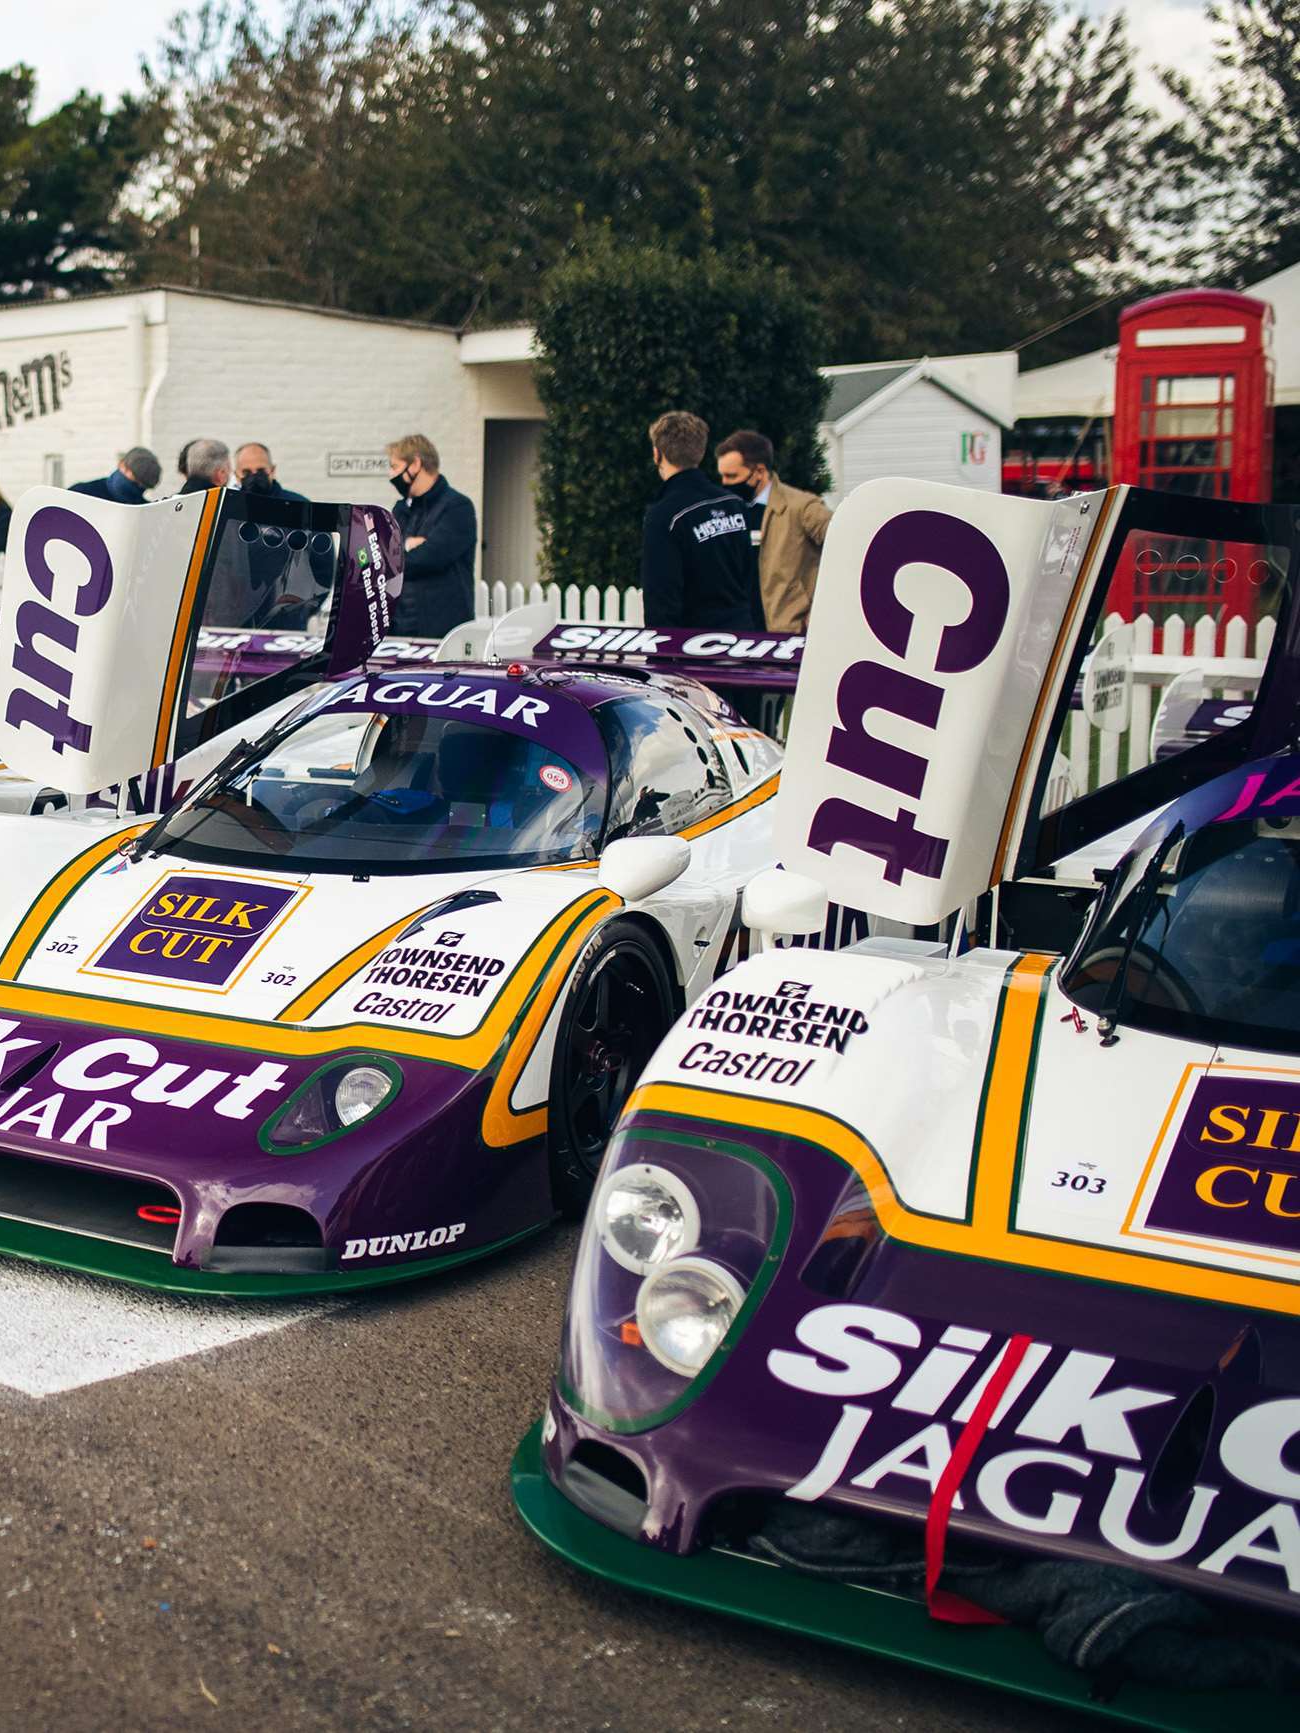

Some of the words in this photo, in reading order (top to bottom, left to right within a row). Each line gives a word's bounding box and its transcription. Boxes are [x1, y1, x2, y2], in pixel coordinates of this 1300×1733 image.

[361, 567, 376, 599] Raul
[367, 532, 383, 570] Eddie
[377, 574, 390, 628] Cheever
[5, 505, 113, 757] Cut
[368, 601, 382, 646] Boesel
[550, 626, 672, 653] Silk
[682, 632, 807, 660] Cut
[302, 681, 551, 728] JAGUAR
[807, 509, 1010, 887] Cut
[147, 892, 269, 930] SILK
[46, 940, 79, 955] 302
[129, 928, 234, 965] CUT
[260, 972, 298, 987] 302
[363, 965, 490, 998] THORESEN
[353, 991, 457, 1024] Castrol
[706, 990, 869, 1036] OWNSEND
[687, 1008, 852, 1056] THORESEN
[51, 1037, 289, 1121] Cut
[678, 1041, 817, 1087] Castrol
[1051, 1170, 1108, 1195] 303
[341, 1222, 468, 1260] DUNLOP
[767, 1302, 1177, 1462] Silk
